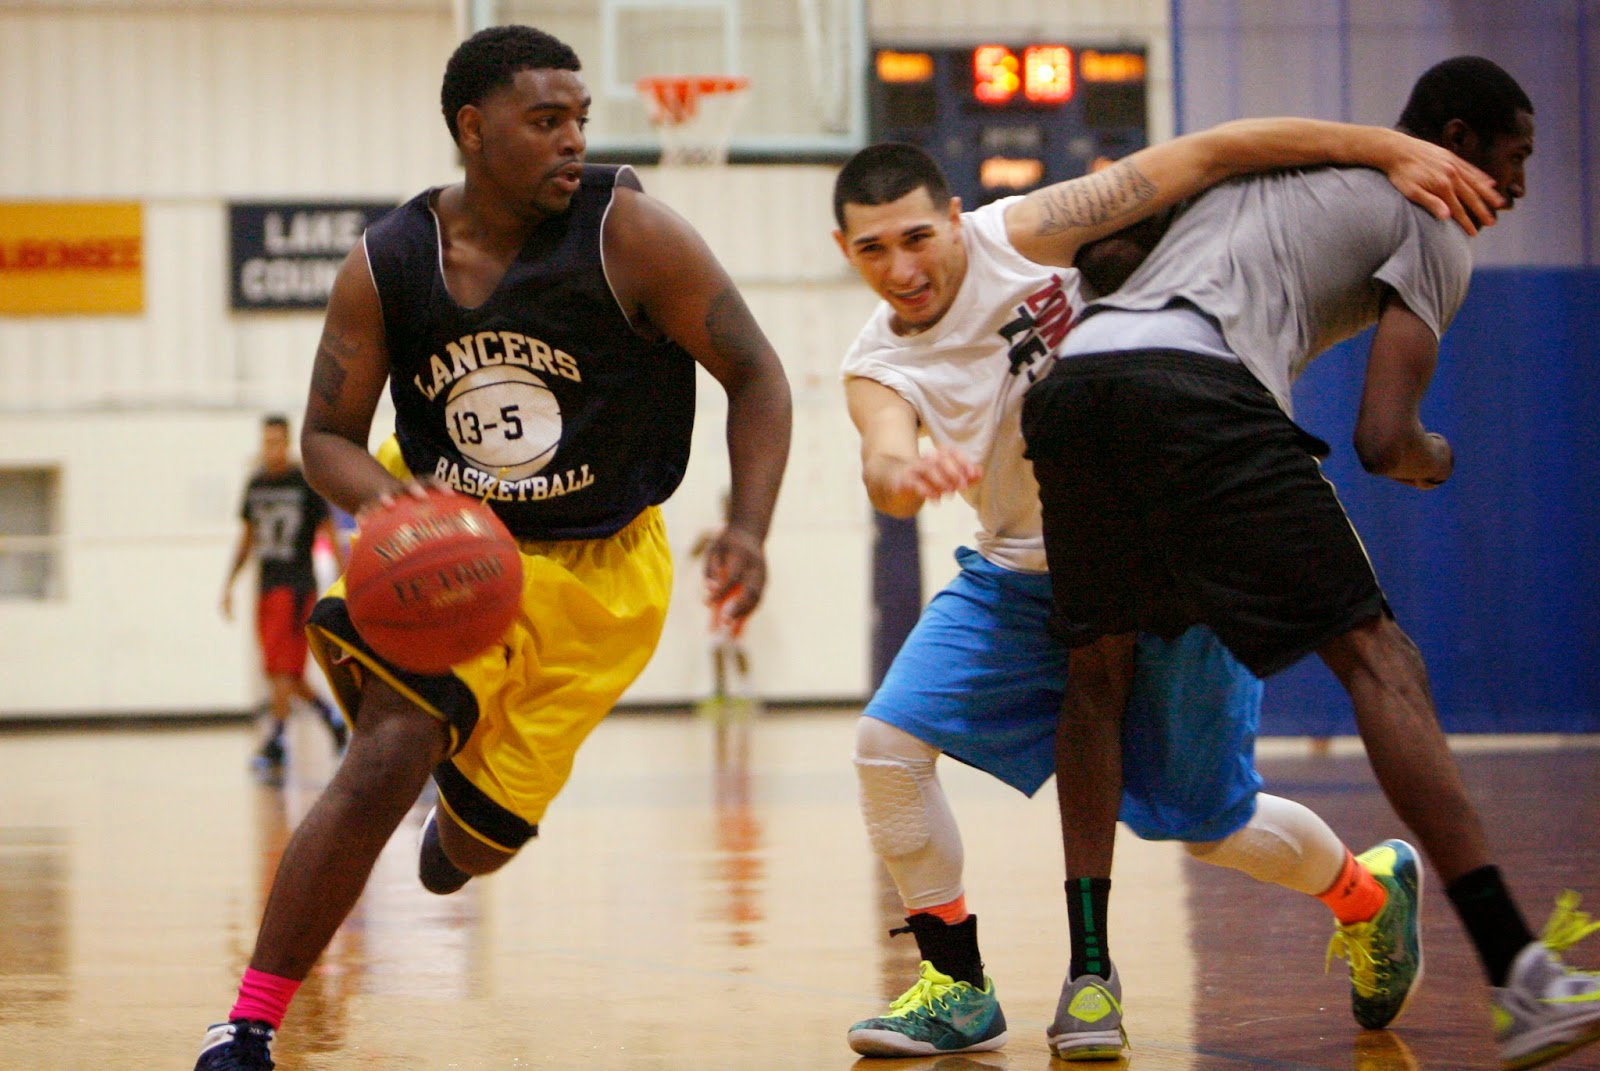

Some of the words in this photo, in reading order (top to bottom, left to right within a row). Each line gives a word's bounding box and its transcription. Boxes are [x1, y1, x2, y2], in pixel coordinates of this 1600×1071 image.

[241, 257, 338, 302] COUN
[413, 331, 582, 401] LANCERS
[453, 405, 523, 445] 13-5
[434, 456, 595, 502] BASKETBALL
